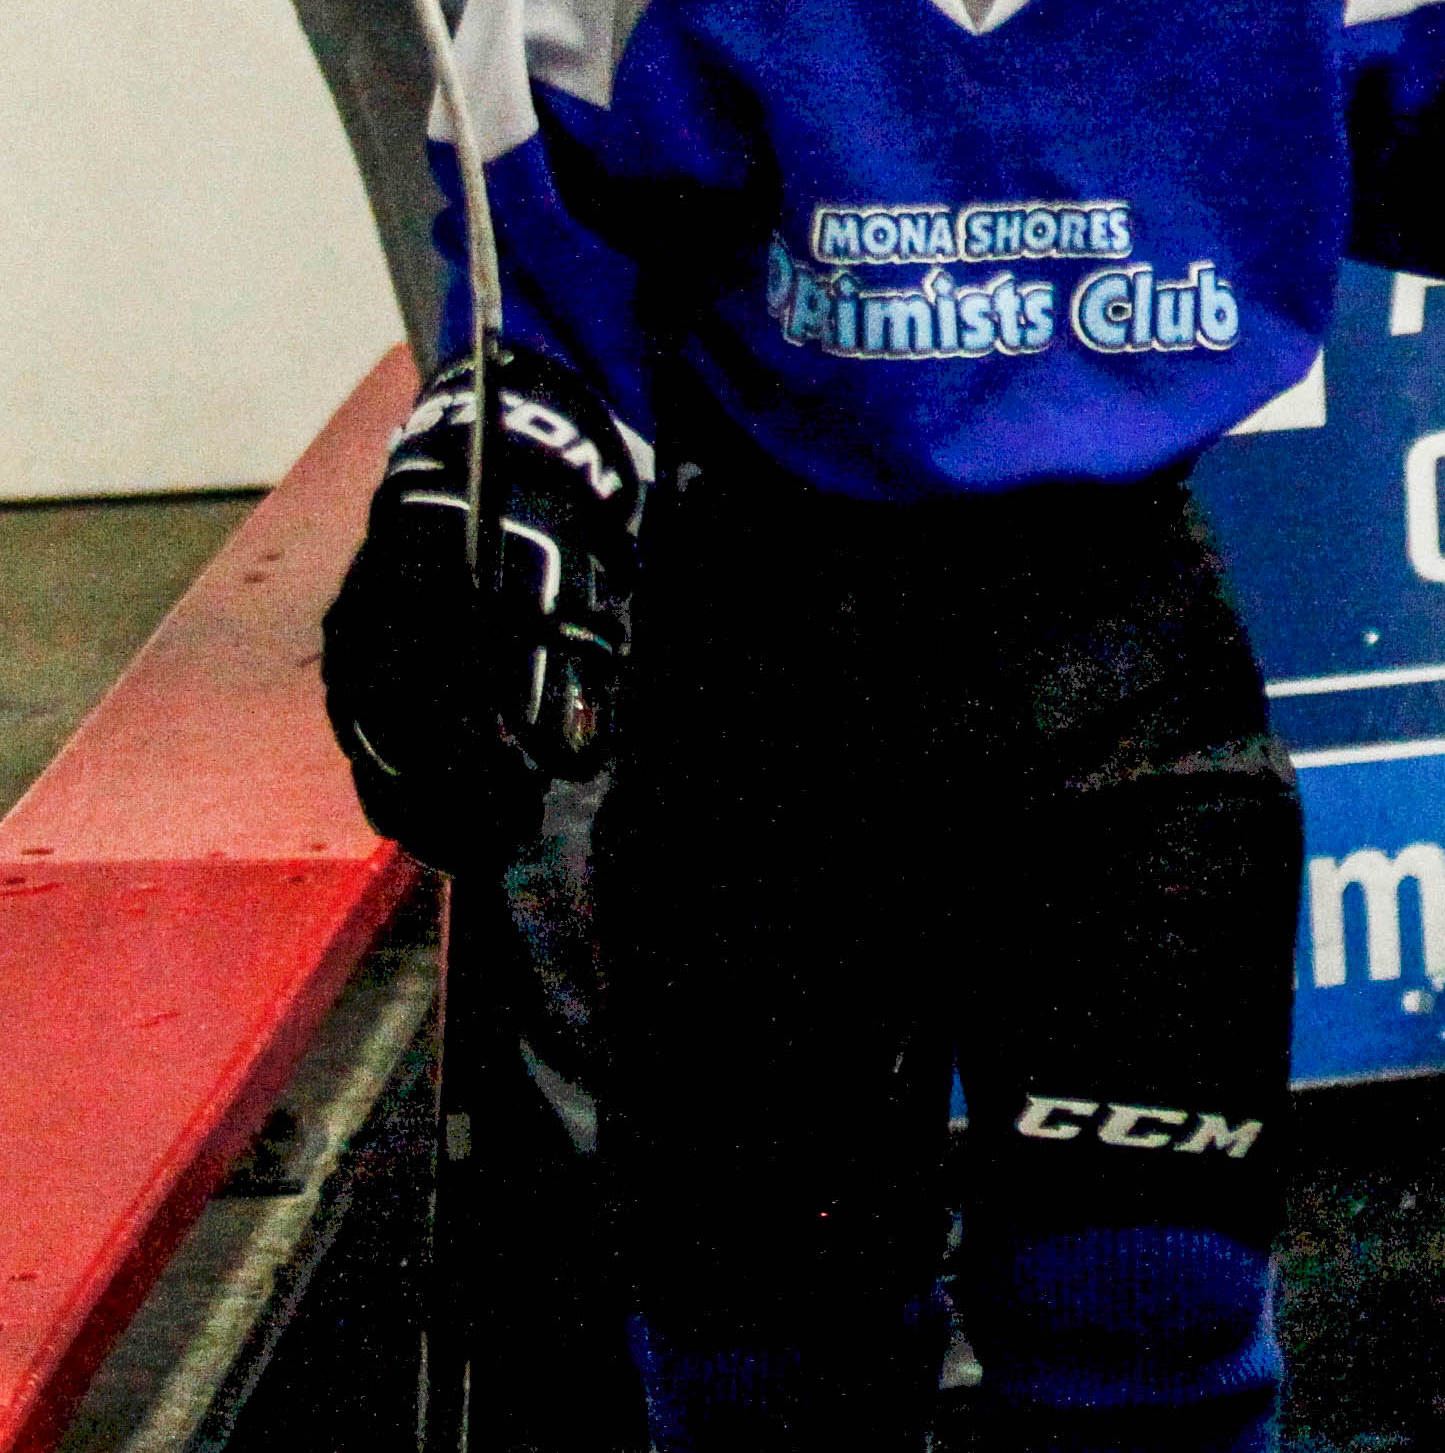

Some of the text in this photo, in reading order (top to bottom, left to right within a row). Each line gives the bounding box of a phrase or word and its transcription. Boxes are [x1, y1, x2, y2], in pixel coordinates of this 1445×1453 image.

[812, 201, 1133, 263] MONA SHORES
[1070, 259, 1241, 353] Club
[1017, 1094, 1264, 1159] CCM
